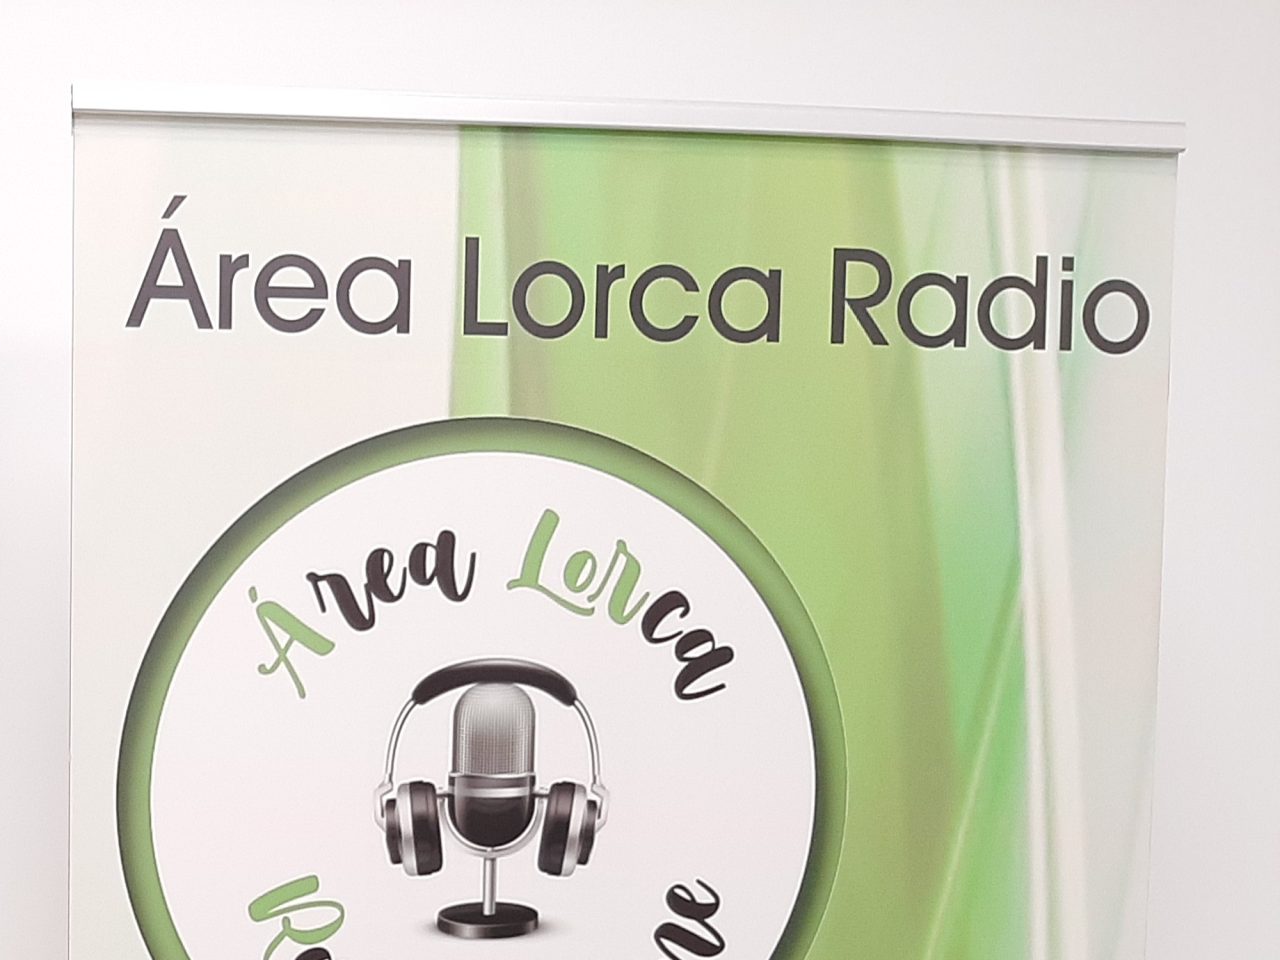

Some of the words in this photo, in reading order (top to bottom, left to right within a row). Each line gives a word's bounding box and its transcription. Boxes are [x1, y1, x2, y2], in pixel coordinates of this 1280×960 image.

[125, 195, 412, 333] Área
[462, 236, 783, 345] Lorca
[830, 247, 1152, 356] Radio
[248, 530, 477, 699] Área
[506, 508, 735, 700] Lorca
